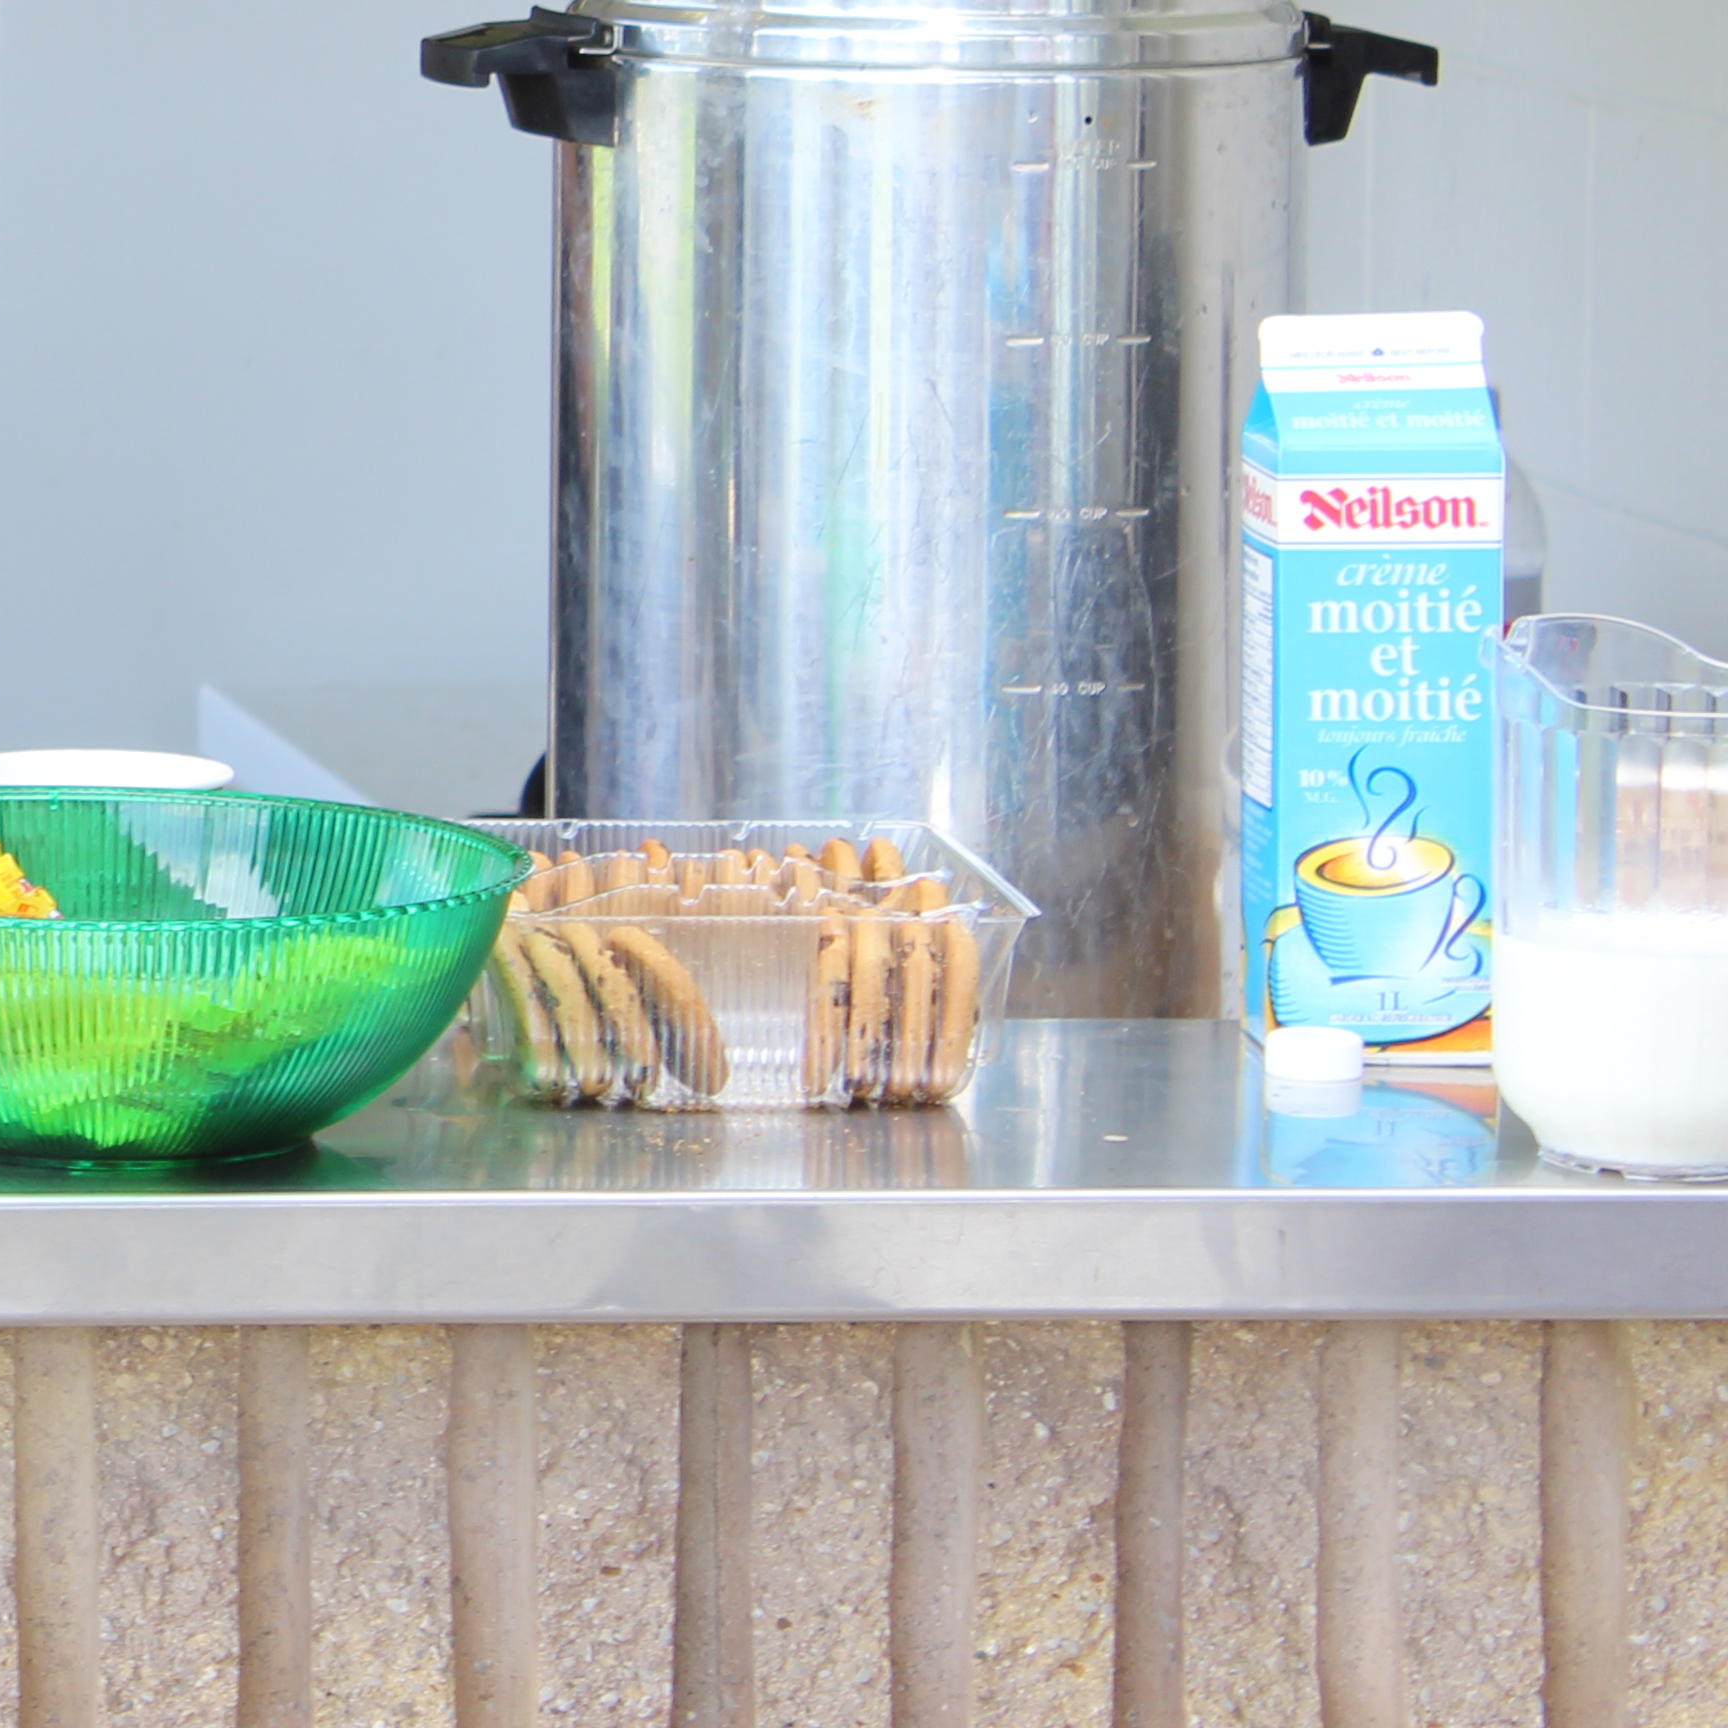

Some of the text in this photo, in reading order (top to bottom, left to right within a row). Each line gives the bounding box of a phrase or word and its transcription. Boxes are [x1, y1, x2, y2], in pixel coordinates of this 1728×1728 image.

[1290, 407, 1486, 430] moitié et moitié
[1299, 485, 1477, 532] Neilson
[1335, 554, 1452, 587] crème
[1307, 585, 1483, 634] moitié
[1369, 636, 1421, 677] et
[1307, 674, 1483, 722] moitié
[1318, 725, 1396, 746] toujours
